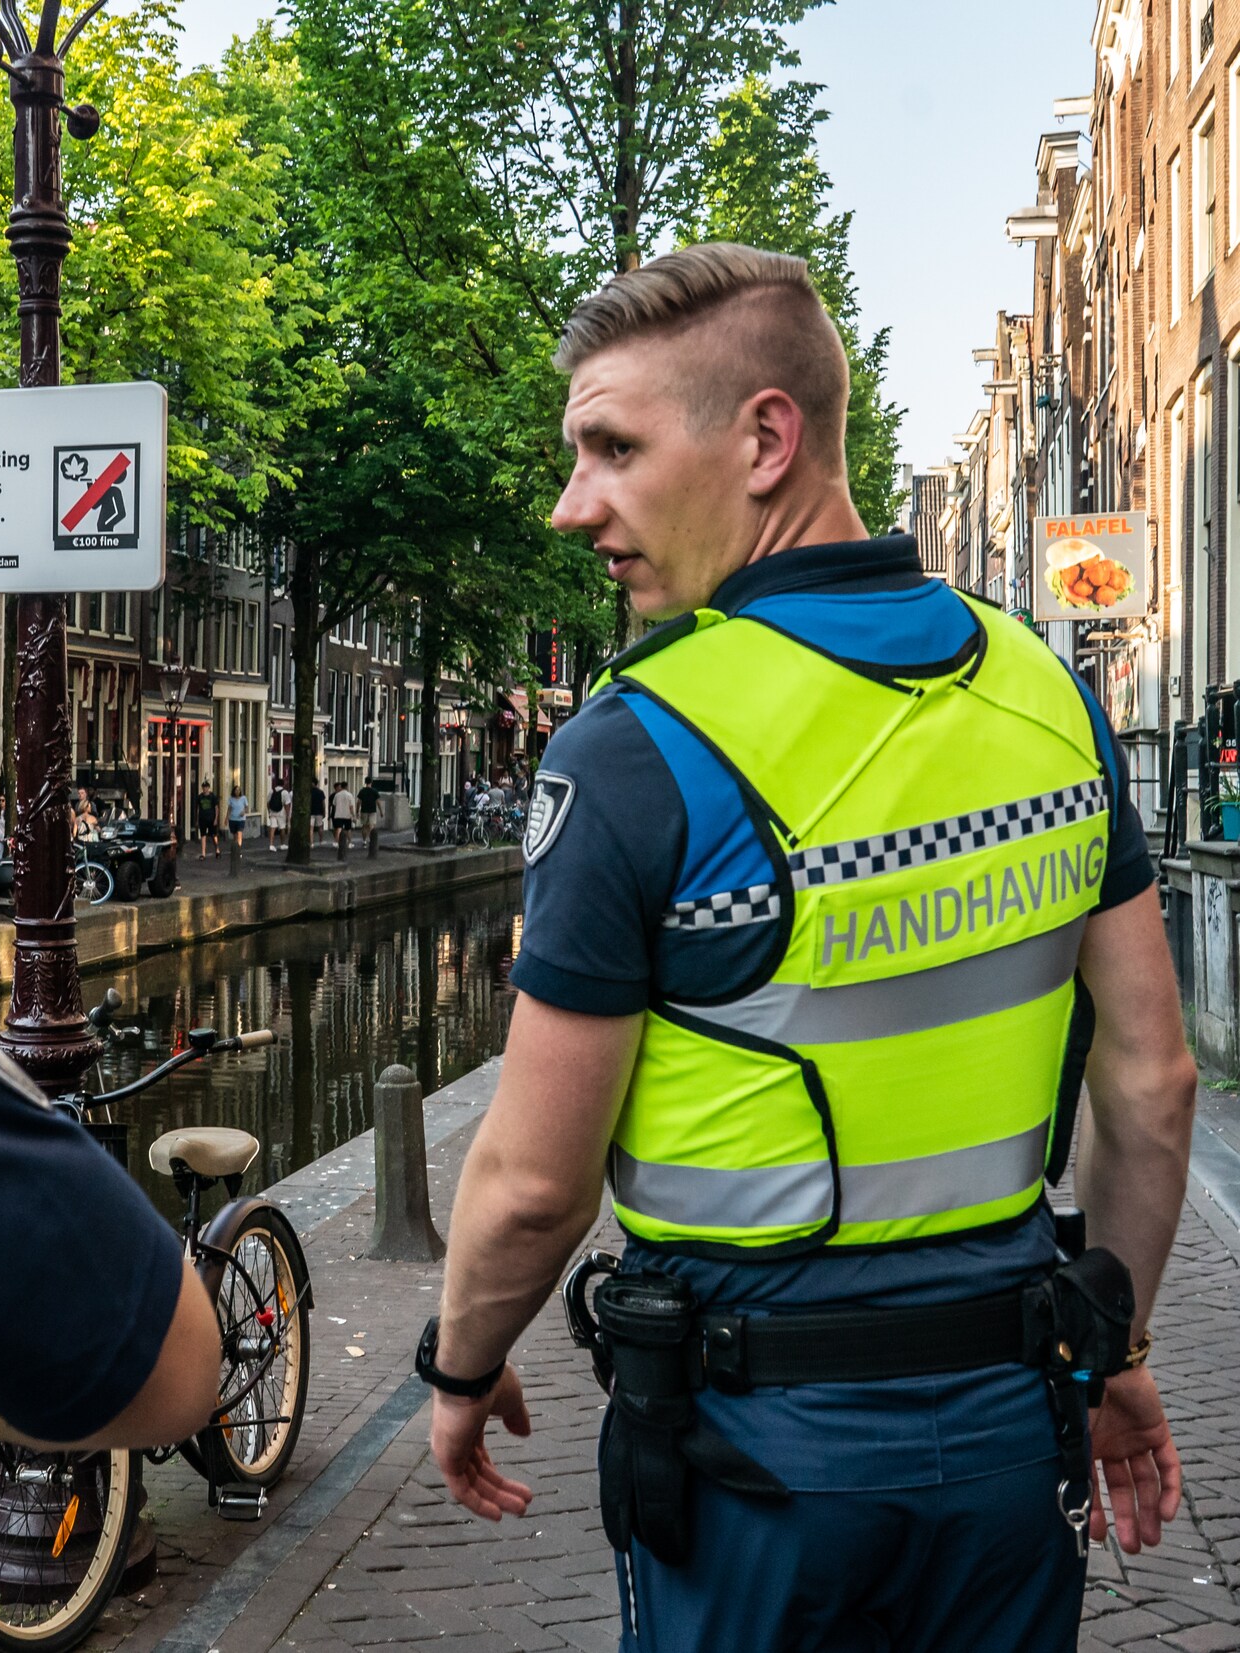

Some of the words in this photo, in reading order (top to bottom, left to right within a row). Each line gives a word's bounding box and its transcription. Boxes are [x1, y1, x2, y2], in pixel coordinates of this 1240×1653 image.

[1046, 517, 1133, 538] FALAFEL
[72, 536, 98, 547] €100
[100, 535, 120, 546] fine
[821, 836, 1104, 967] HANDHAVING
